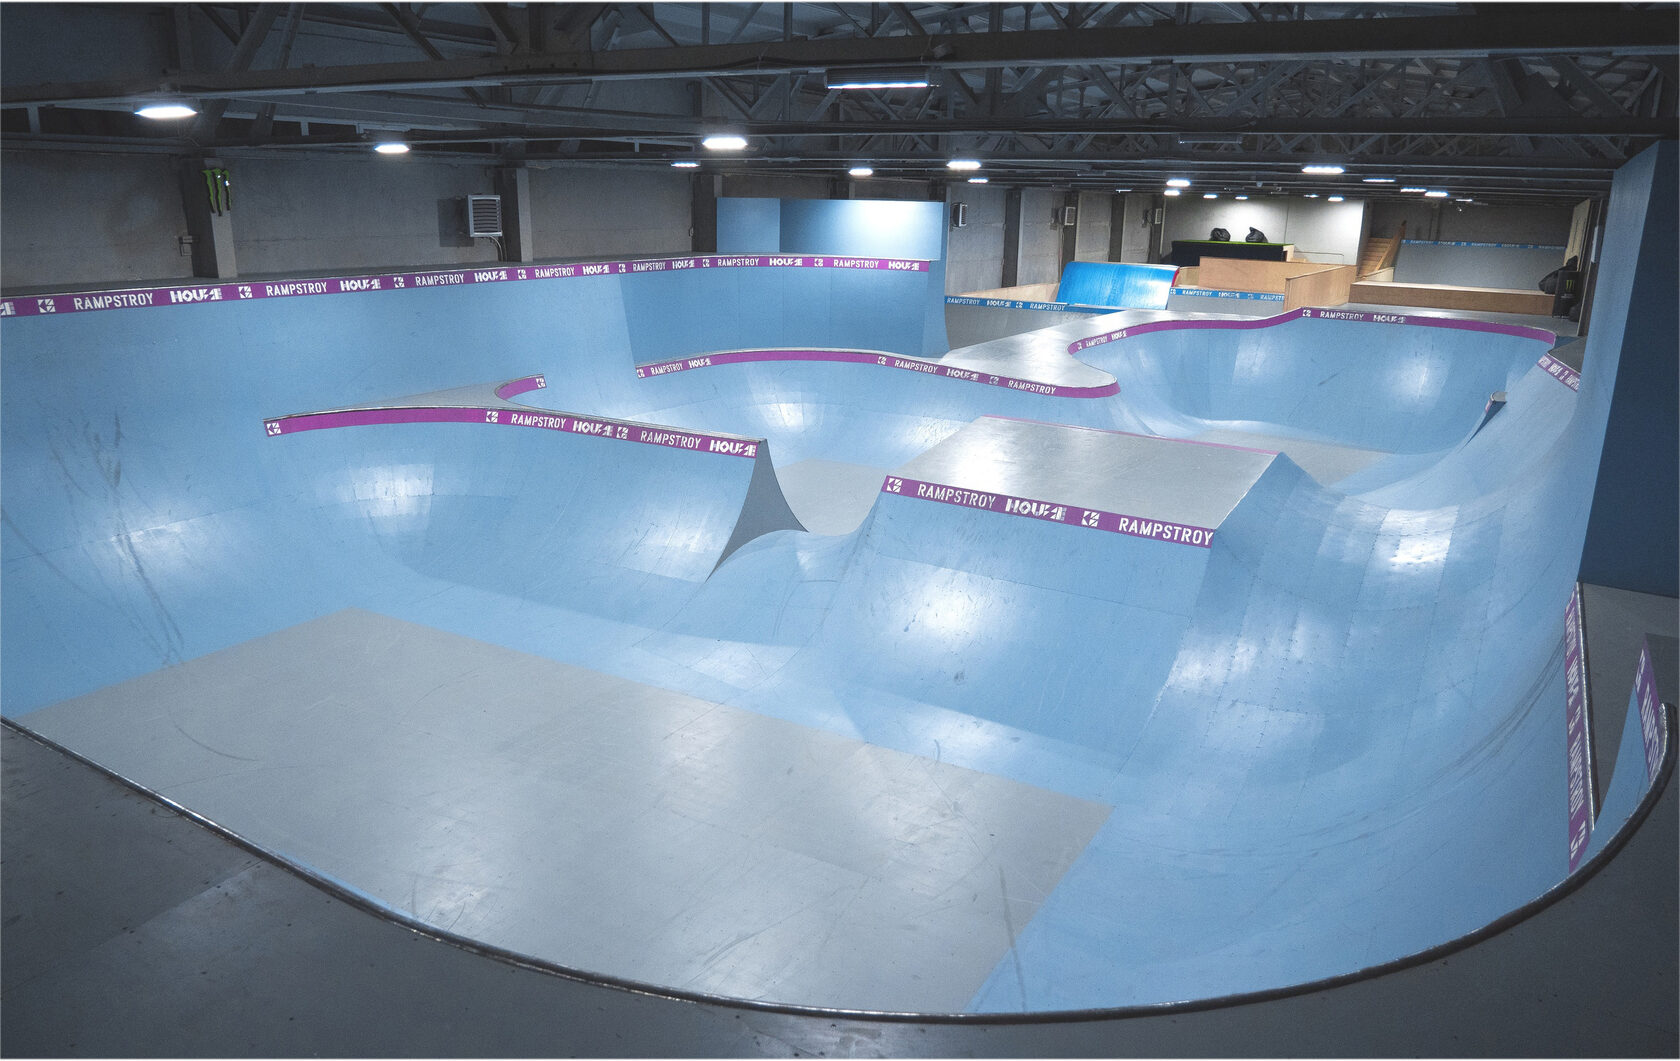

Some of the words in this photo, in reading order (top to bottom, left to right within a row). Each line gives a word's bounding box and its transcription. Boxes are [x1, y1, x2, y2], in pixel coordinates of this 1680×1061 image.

[632, 262, 666, 272] RAMPSTROY
[717, 258, 759, 268] RAMPSTROY
[833, 259, 879, 269] RAMPSTROY
[535, 267, 575, 278] RAMPSTROY
[415, 273, 464, 286] RAMPSTROY
[266, 282, 327, 296] RAMPSTROY
[74, 293, 153, 310] RAMPSTROY
[947, 297, 980, 305] RAMPSTROY
[1030, 303, 1065, 311] RAMPSTROY
[1320, 311, 1364, 320] RAMPSTROY
[650, 362, 684, 375] RAMPSTROY
[895, 359, 938, 374] RAMPSTROY
[1008, 380, 1056, 395] RAMPSTROY
[510, 412, 566, 429] RAMPSTROY
[640, 430, 701, 449] RAMPSTROY
[917, 483, 996, 509] RAMPSTROY
[1118, 517, 1214, 546] RAMPSTROY
